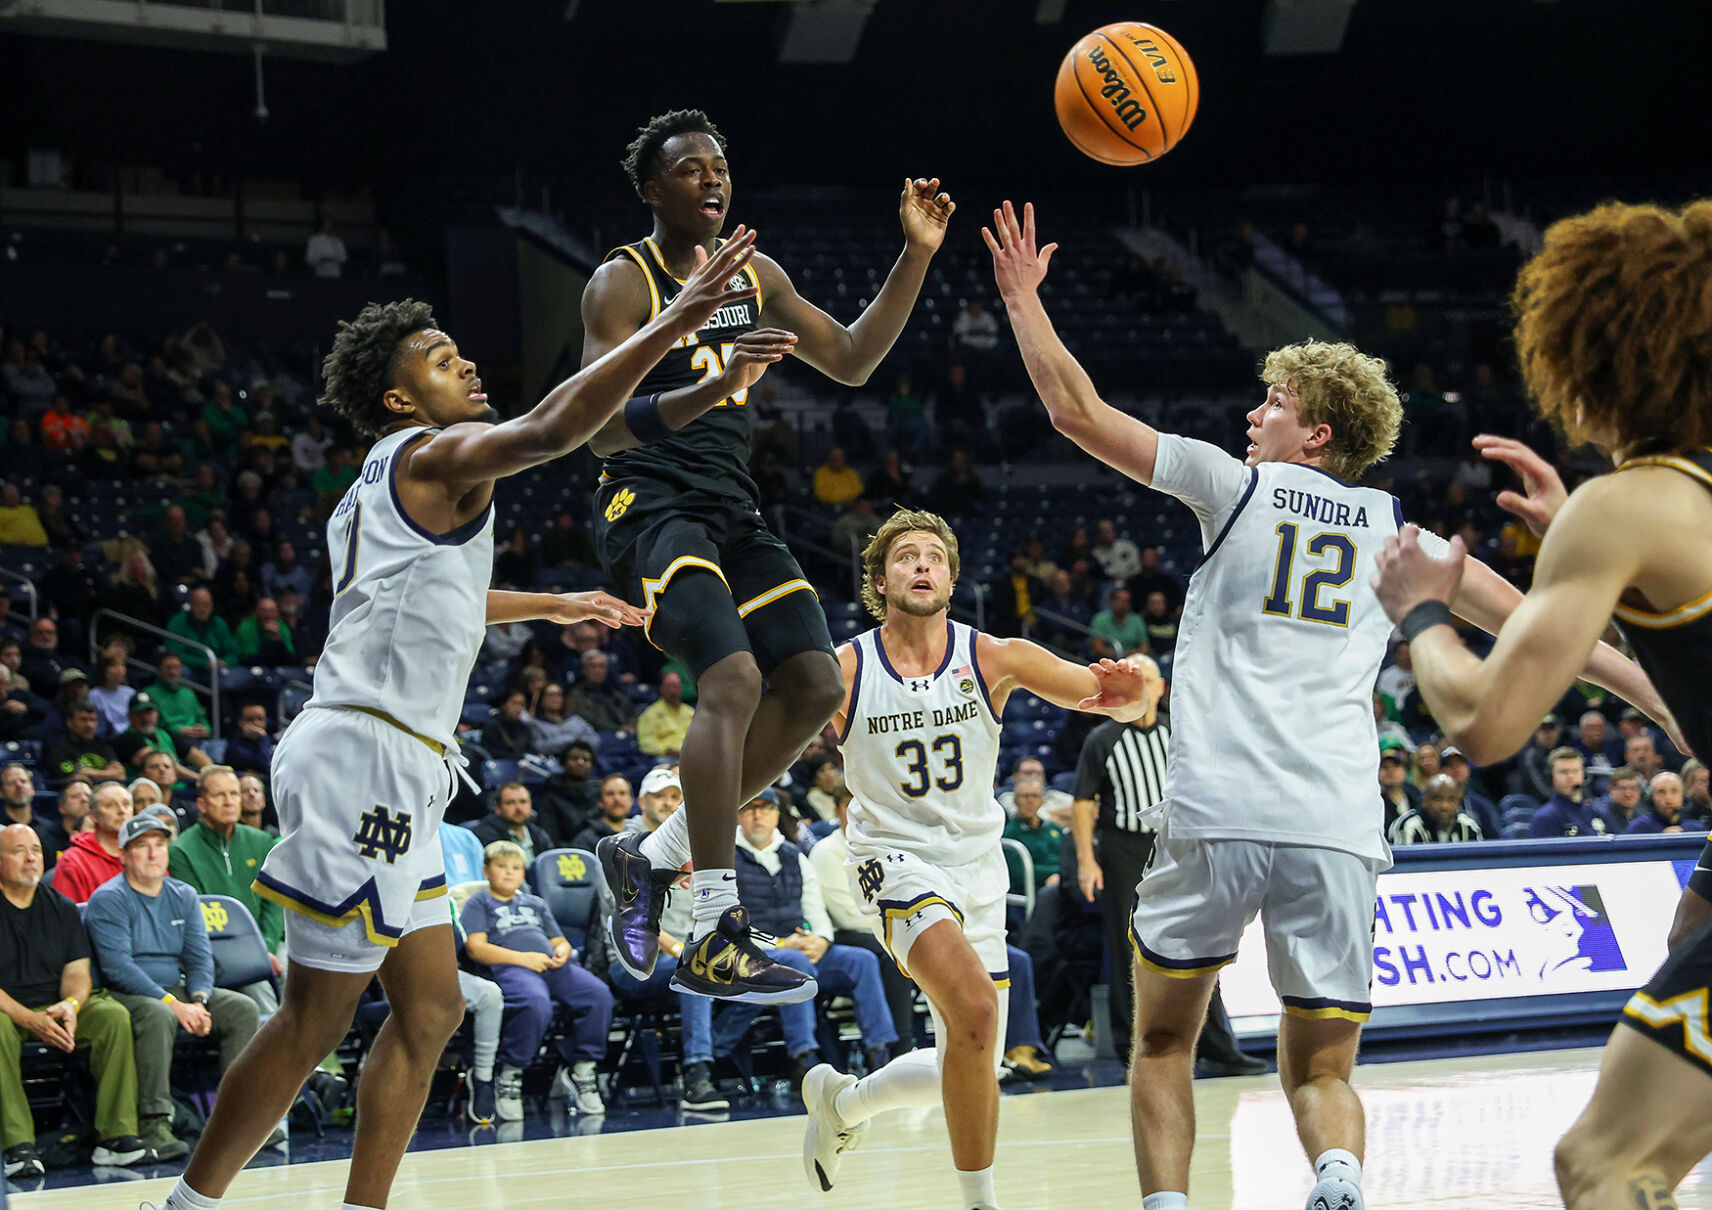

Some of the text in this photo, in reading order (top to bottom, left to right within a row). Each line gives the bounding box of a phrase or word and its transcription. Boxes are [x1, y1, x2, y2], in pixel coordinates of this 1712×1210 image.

[1088, 45, 1147, 132] Wilson
[1273, 488, 1369, 528] SUNDRA
[1262, 520, 1358, 628] 12
[867, 700, 978, 734] NOTRE DAME
[895, 733, 964, 799] 33
